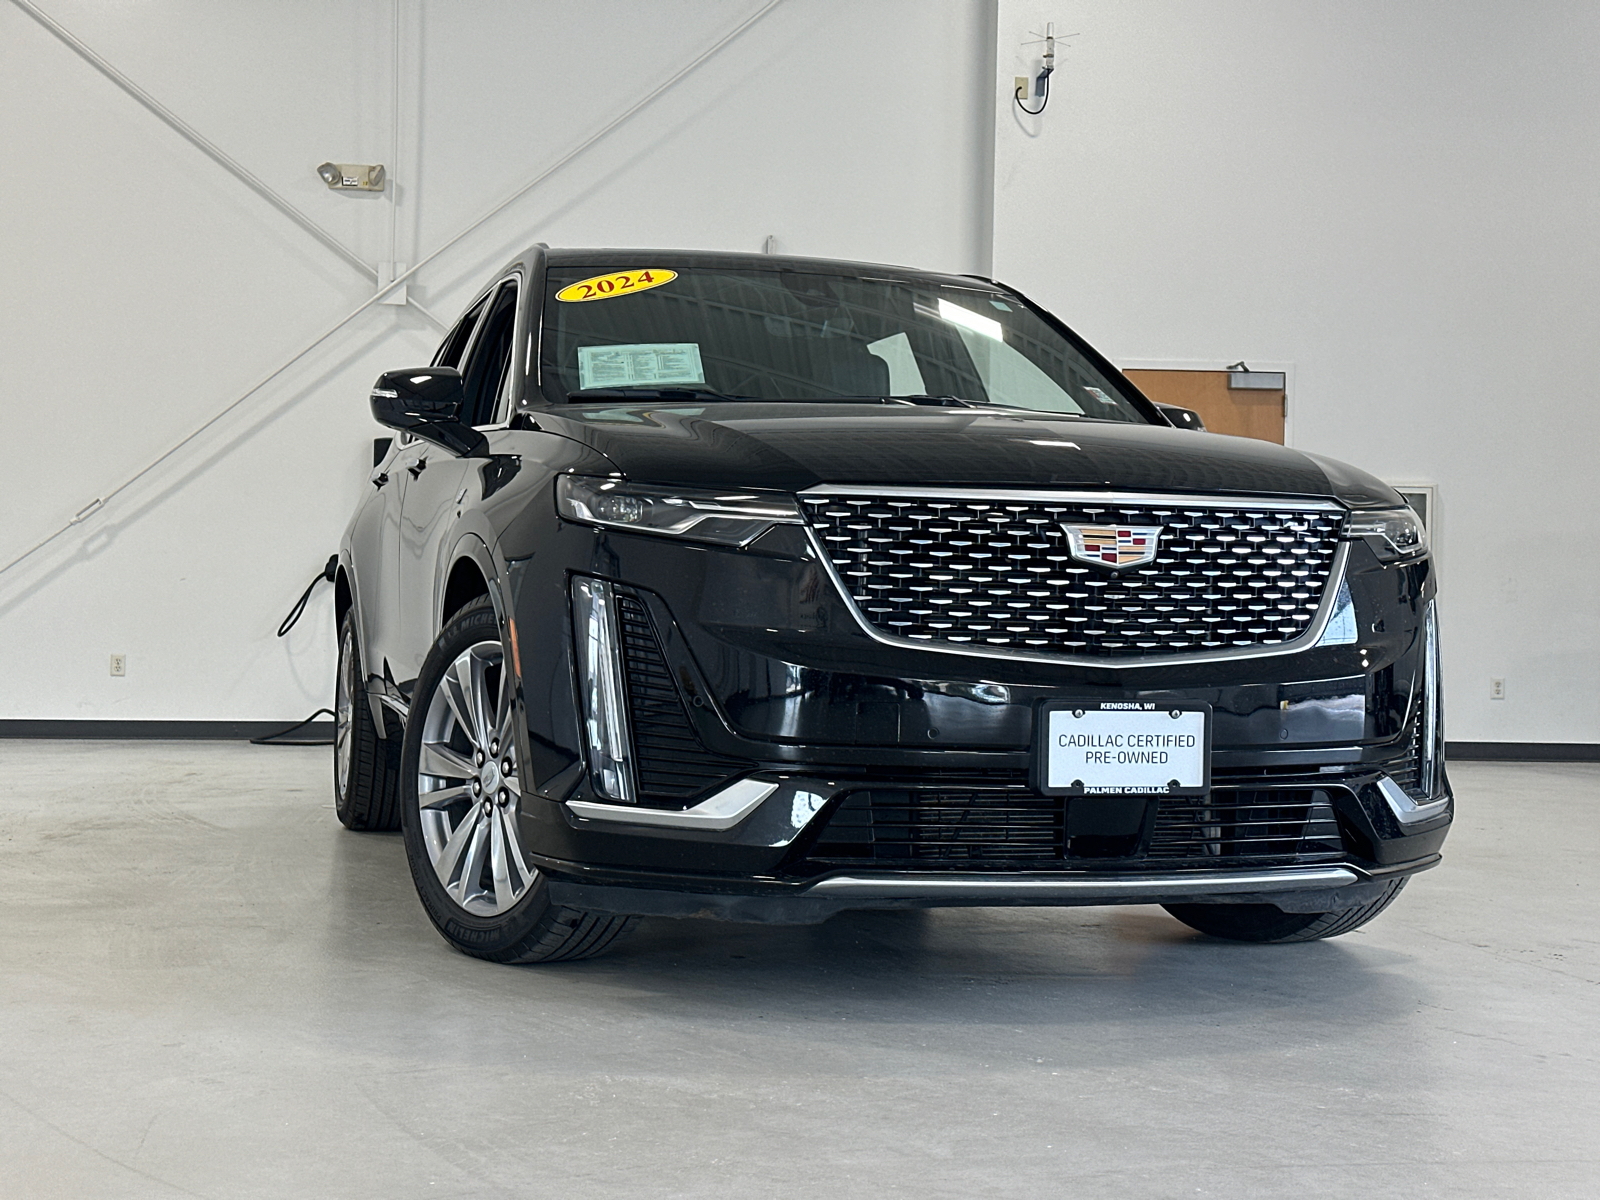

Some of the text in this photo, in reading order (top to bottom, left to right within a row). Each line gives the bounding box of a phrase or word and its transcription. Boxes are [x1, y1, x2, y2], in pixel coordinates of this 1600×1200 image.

[577, 271, 655, 299] 2024
[460, 613, 497, 632] MICHE
[1100, 702, 1156, 711] KENOSHA, WI
[1058, 734, 1196, 748] CADILLAC CERTIFIED
[1085, 751, 1169, 764] PRE-OWNED
[1083, 787, 1170, 795] PALMEN CADILLAC
[420, 885, 442, 921] PRIMACY
[445, 921, 501, 943] MICHELIN
